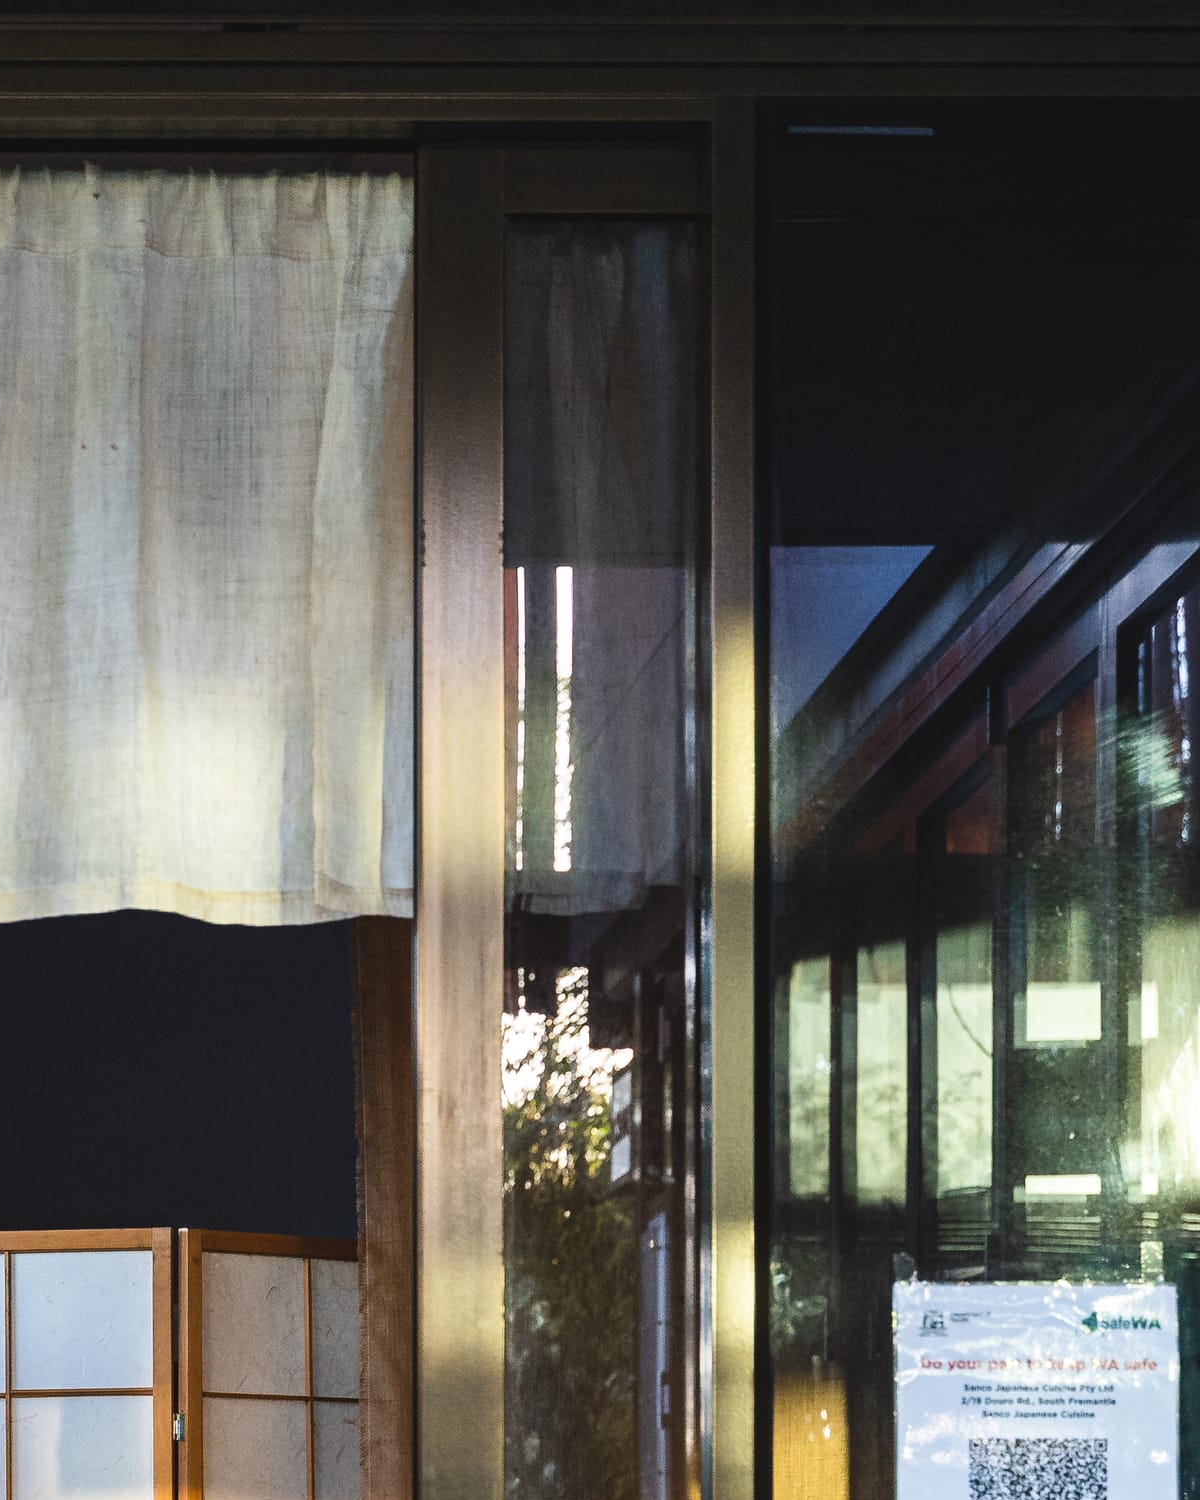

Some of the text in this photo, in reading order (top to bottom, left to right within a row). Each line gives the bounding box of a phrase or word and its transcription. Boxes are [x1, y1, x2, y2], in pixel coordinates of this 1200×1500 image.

[1100, 1315, 1162, 1330] SafeWA
[920, 1357, 943, 1370] Do
[1123, 1358, 1158, 1371] safe
[996, 1384, 1039, 1394] Japanese
[1042, 1385, 1076, 1393] Cuisine
[1038, 1397, 1065, 1406] South
[1068, 1397, 1117, 1406] Fremantle
[1014, 1410, 1057, 1419] Japanese
[1060, 1410, 1096, 1418] Cuisine
